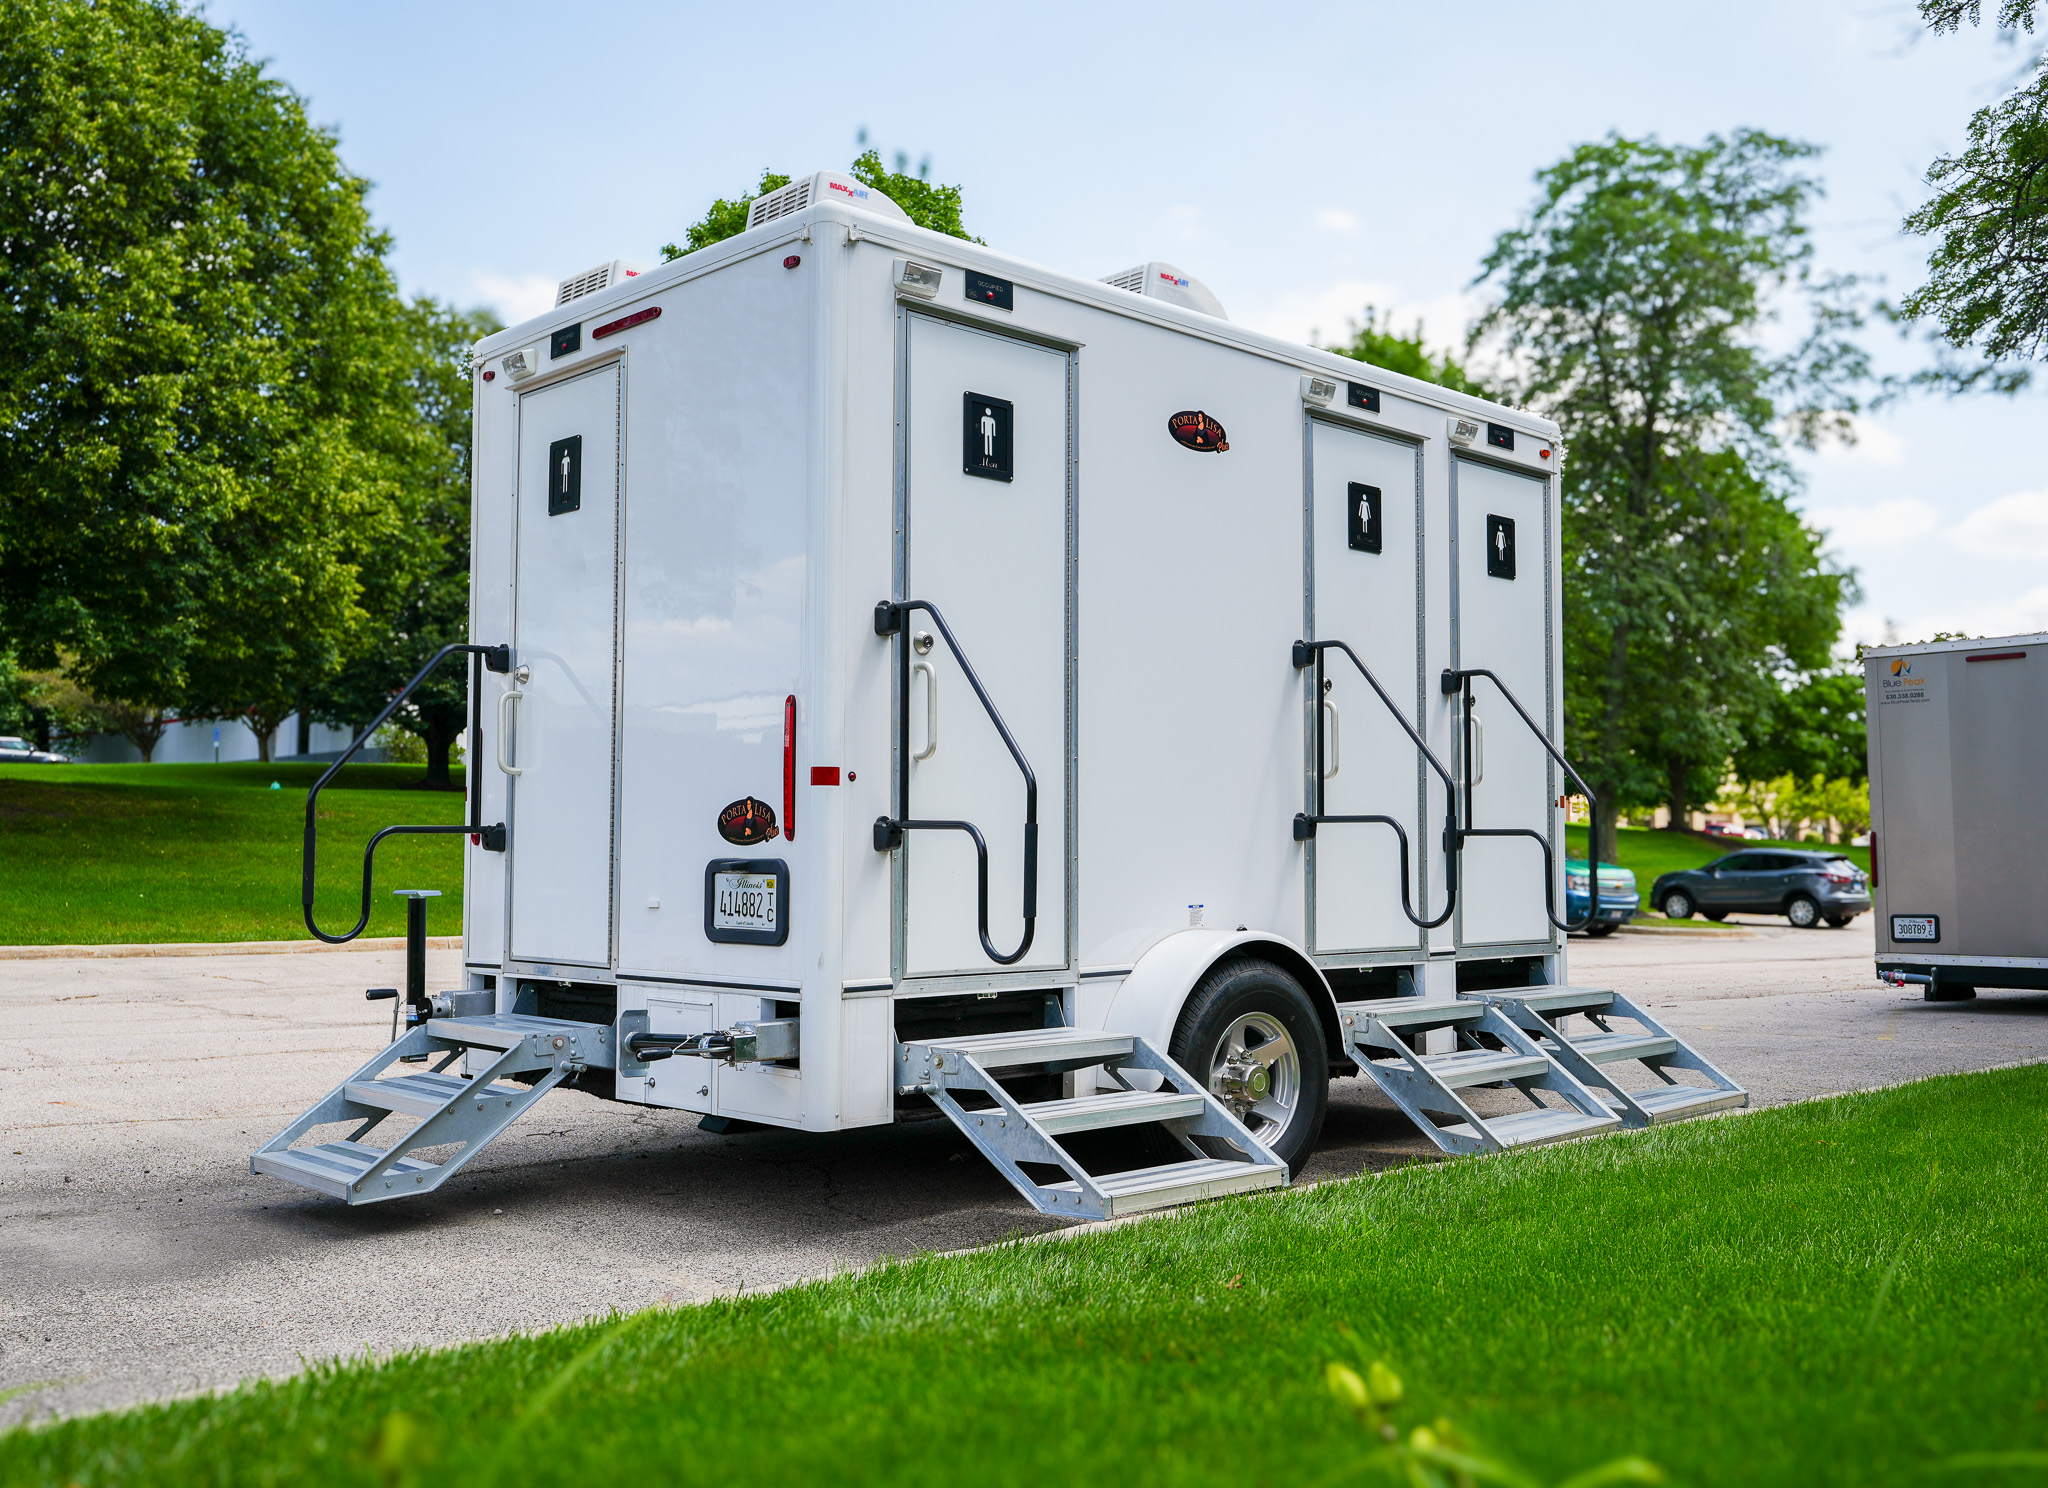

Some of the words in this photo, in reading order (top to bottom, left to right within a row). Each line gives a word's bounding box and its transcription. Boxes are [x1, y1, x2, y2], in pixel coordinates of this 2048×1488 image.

[977, 280, 1004, 292] OCCUPIED
[1172, 415, 1198, 429] PORTA
[1206, 418, 1222, 437] LISA
[1882, 679, 1902, 688] Blue
[1903, 677, 1926, 687] Peak
[1885, 692, 1925, 701] 630.338.0288
[721, 805, 747, 826] PORTA
[755, 803, 771, 822] LISA
[729, 878, 763, 890] Illinois
[720, 890, 763, 918] 414882
[1898, 924, 1926, 935] 308789
